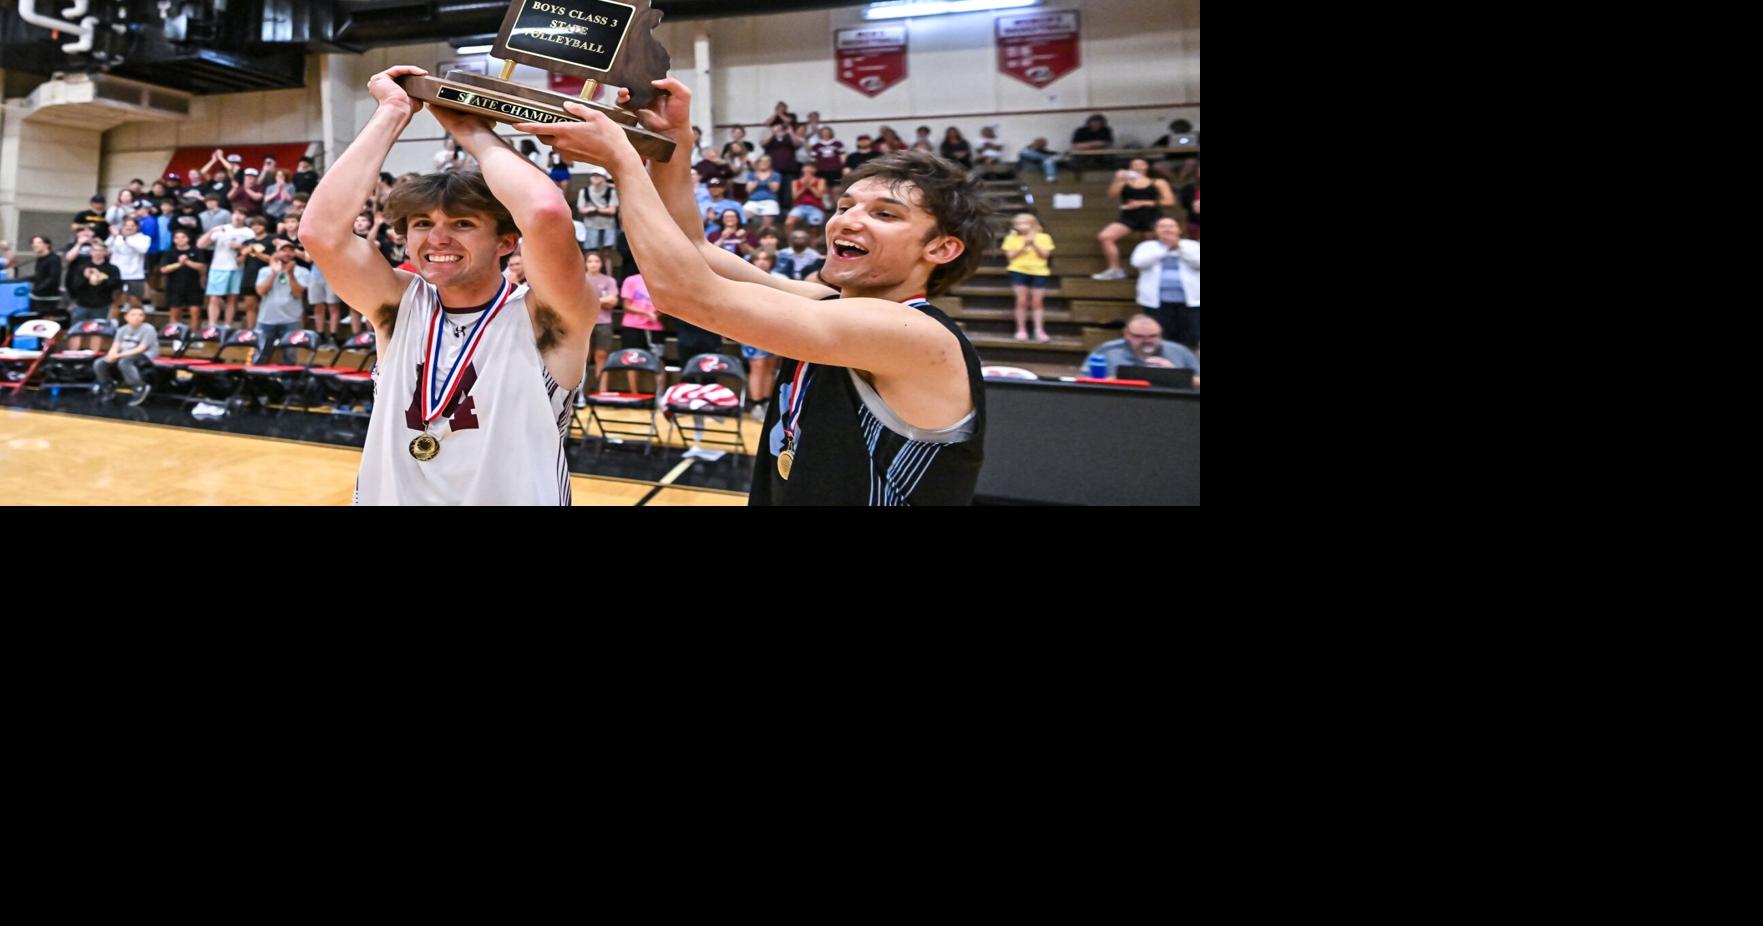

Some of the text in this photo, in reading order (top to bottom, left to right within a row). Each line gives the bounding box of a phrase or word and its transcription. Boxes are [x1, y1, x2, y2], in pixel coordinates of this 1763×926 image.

[532, 1, 618, 28] BOYS CLASS 3
[550, 19, 589, 36] STATE
[457, 92, 499, 110] STATE
